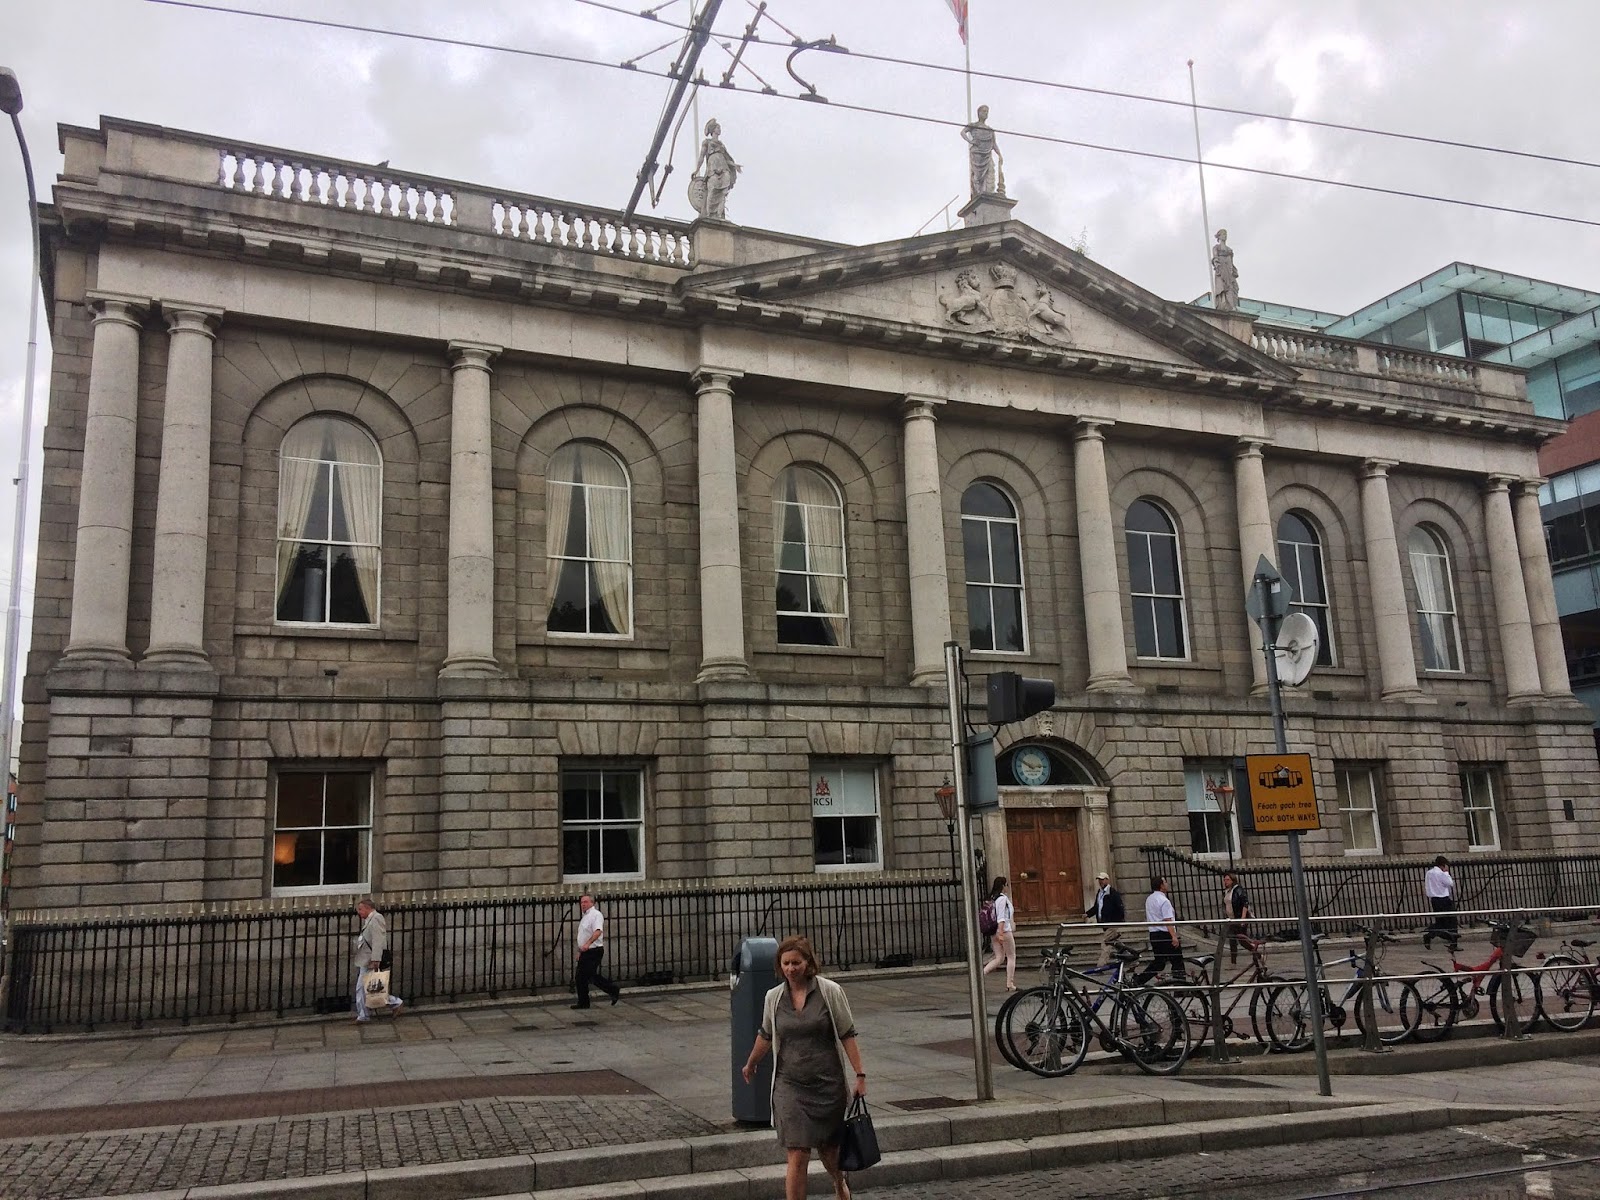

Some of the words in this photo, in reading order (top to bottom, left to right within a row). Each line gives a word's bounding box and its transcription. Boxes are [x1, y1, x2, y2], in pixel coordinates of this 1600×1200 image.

[813, 797, 833, 806] RCSI
[1257, 801, 1277, 810] Féach
[1280, 801, 1295, 810] gach
[1298, 801, 1312, 809] treo
[1256, 815, 1275, 823] LOOK
[1277, 814, 1295, 822] BOTH
[1298, 813, 1316, 821] WAYS
